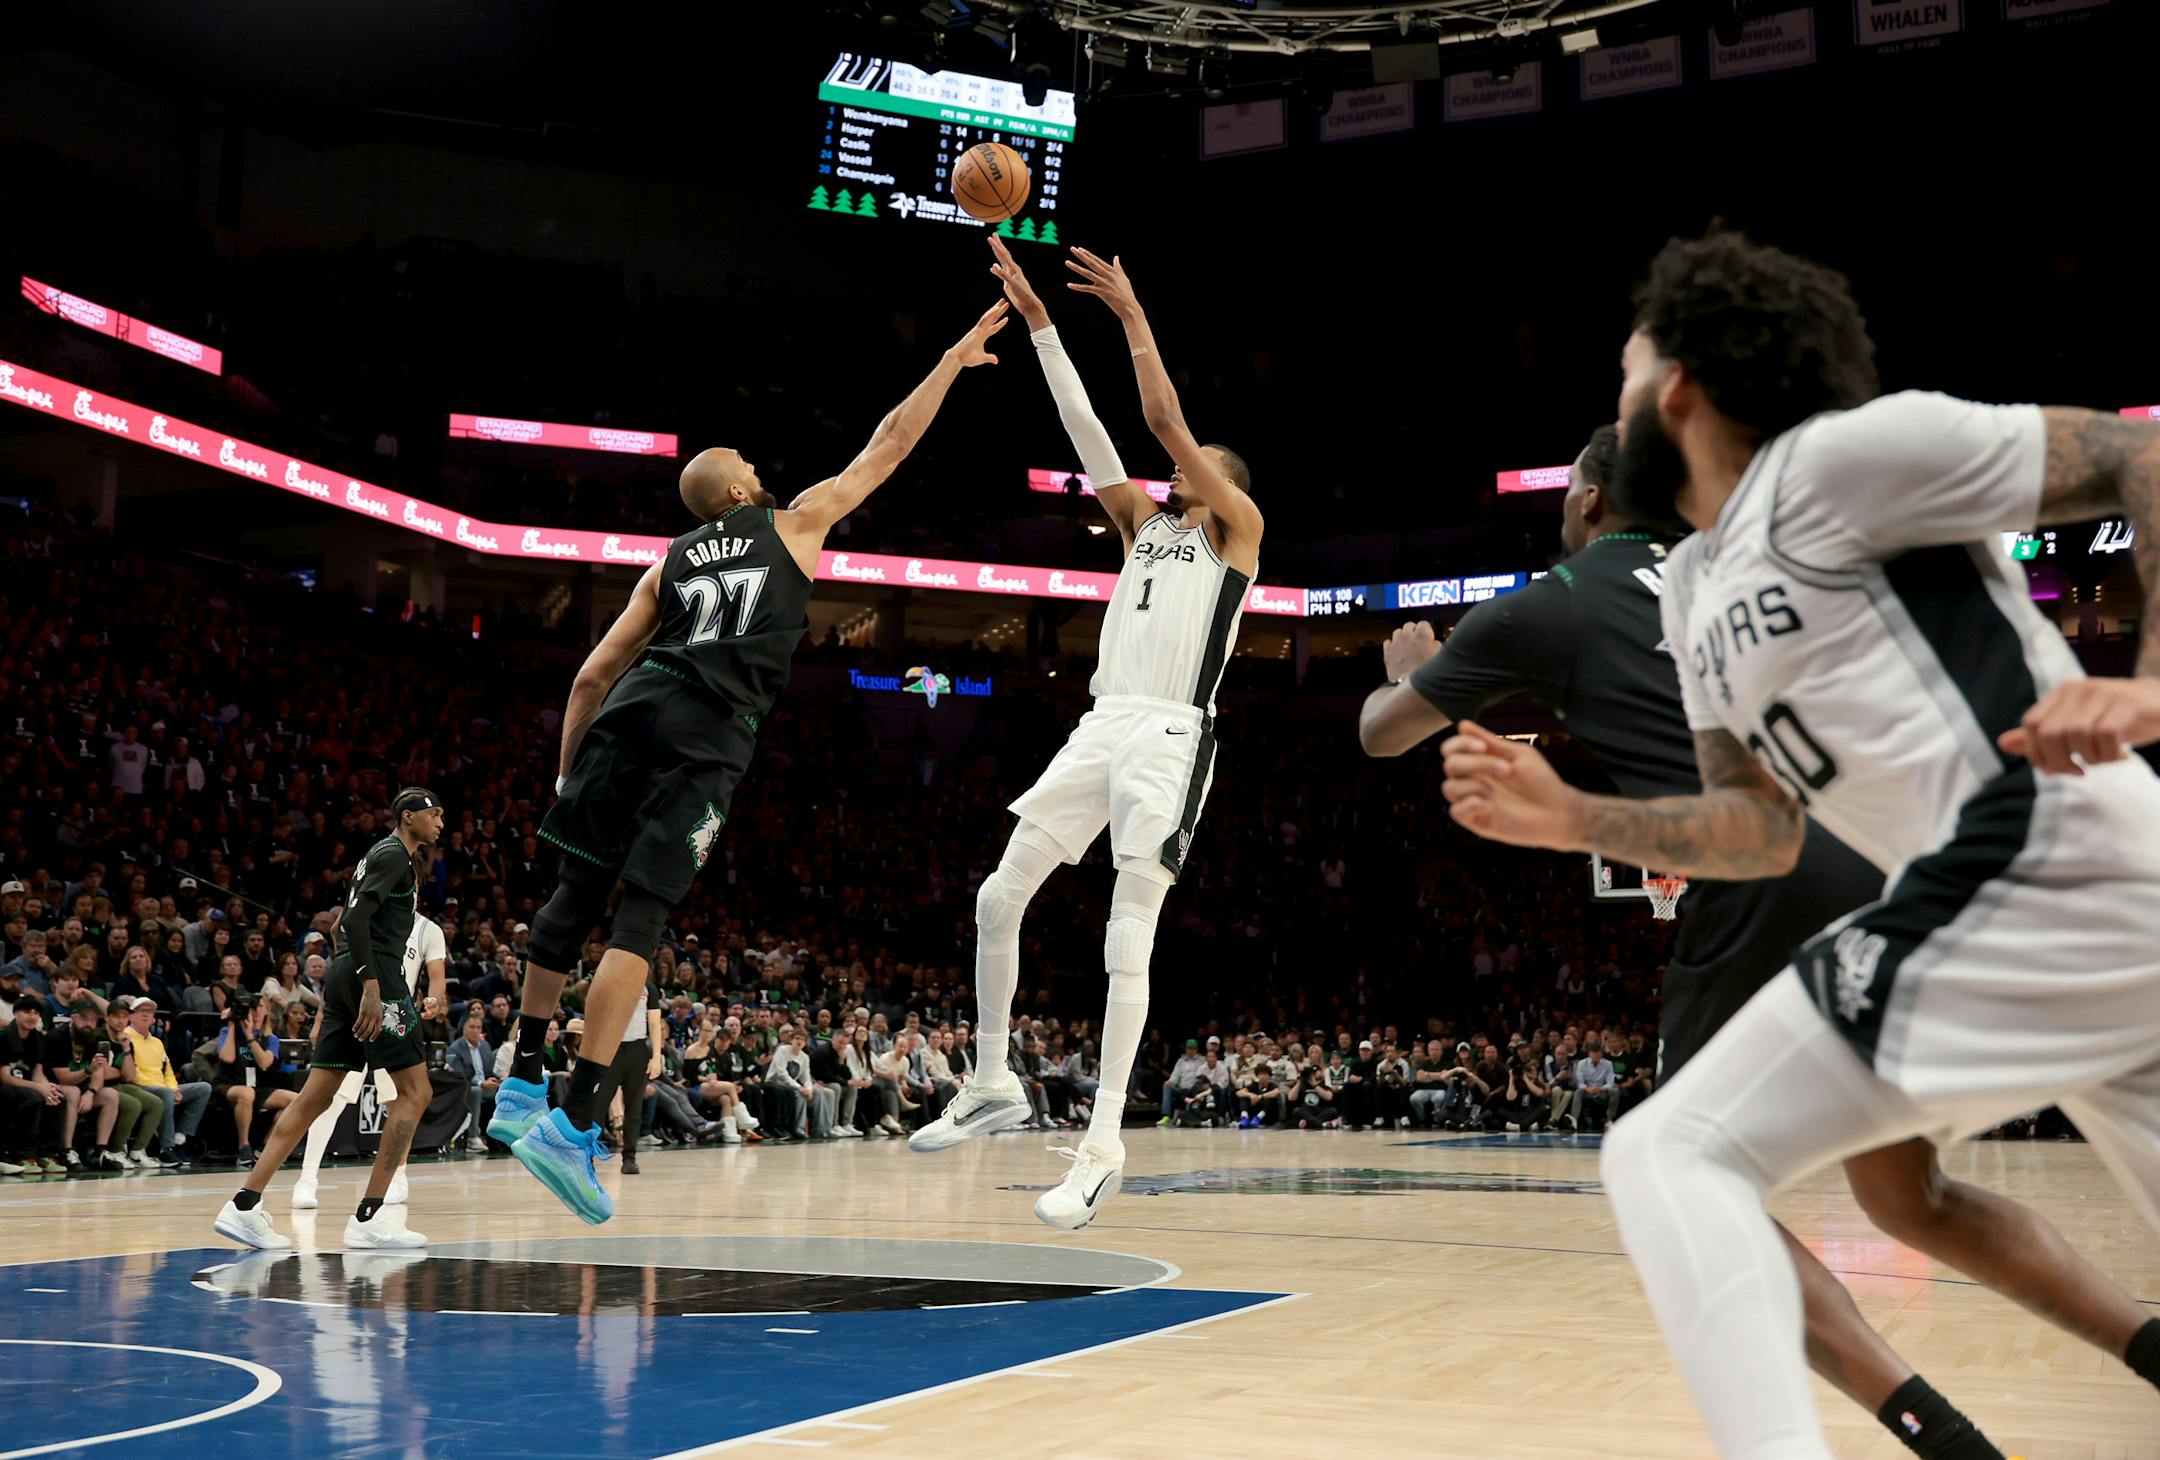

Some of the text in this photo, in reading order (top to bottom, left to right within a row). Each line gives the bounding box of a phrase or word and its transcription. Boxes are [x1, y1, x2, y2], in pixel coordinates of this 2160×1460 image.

[1870, 4, 1947, 33] WHALEN
[1609, 49, 1651, 68] WNBA
[1718, 39, 1807, 64] CHAMPIONS
[1588, 60, 1673, 86] CHAMPIONS
[1347, 92, 1386, 107] WNBA
[1452, 86, 1533, 107] CHAMPIONS
[843, 107, 908, 128] Wembanyama
[956, 126, 968, 138] 14
[1328, 105, 1406, 128] CHAMPIONS
[826, 120, 833, 130] 2
[841, 122, 875, 137] Harper
[955, 141, 963, 151] 4
[840, 137, 870, 151] Castle
[820, 149, 833, 159] 24
[838, 151, 873, 166] Vassell
[976, 143, 1003, 181] Wilson
[836, 166, 895, 185] Champagnie
[916, 195, 956, 215] Treasure
[48, 288, 104, 318] SANDARD
[478, 419, 539, 433] STANDARD
[593, 430, 650, 443] STANDARD
[1523, 467, 1571, 480] STANDA
[2044, 532, 2056, 541] 10
[685, 537, 754, 567] GOBERT
[2047, 542, 2055, 554] 2
[1136, 579, 1153, 610] 1
[1310, 589, 1332, 602] NYK
[1399, 579, 1461, 608] KFAN
[673, 565, 770, 646] 27
[1310, 594, 1364, 616] PHI 94 4
[848, 669, 992, 696] Treasure Island
